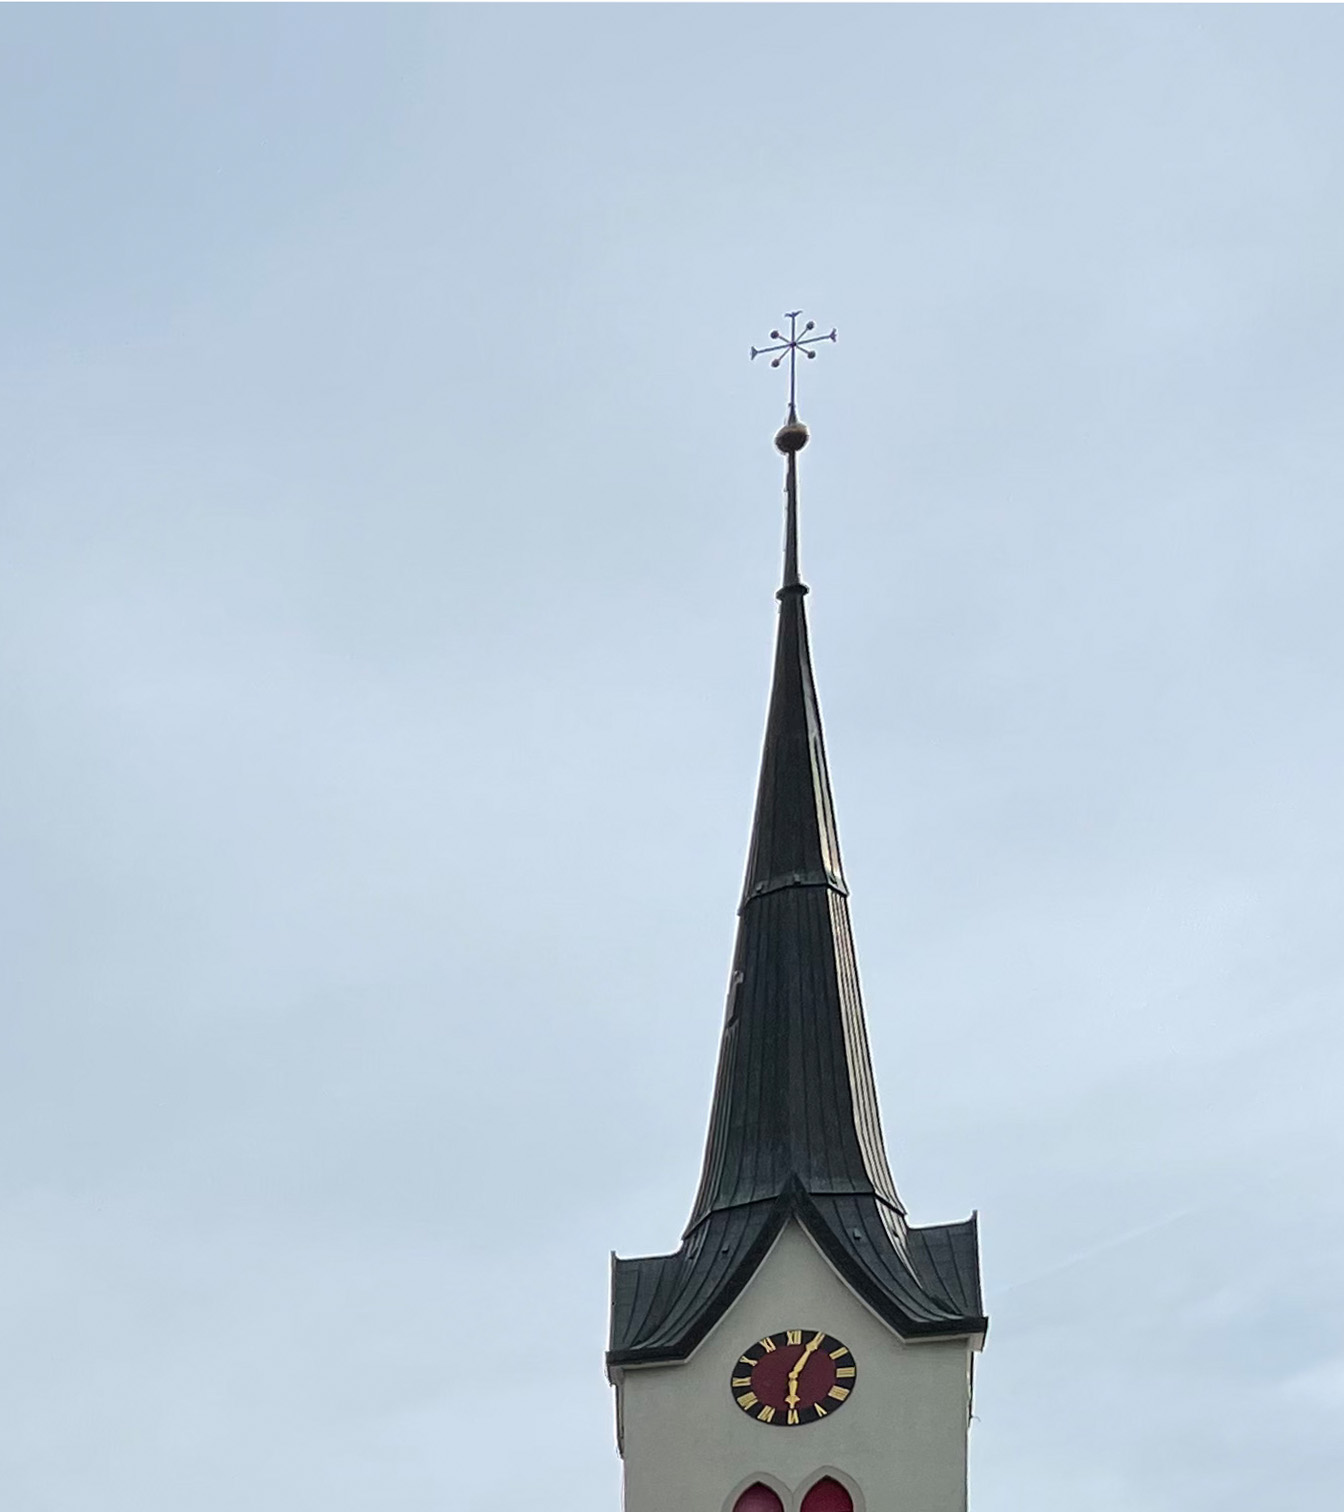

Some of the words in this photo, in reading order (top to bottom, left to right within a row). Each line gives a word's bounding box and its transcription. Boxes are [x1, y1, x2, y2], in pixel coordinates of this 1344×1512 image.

[759, 1336, 777, 1353] XI
[786, 1330, 802, 1346] XII
[739, 1355, 758, 1367] X
[813, 1402, 828, 1417] V
